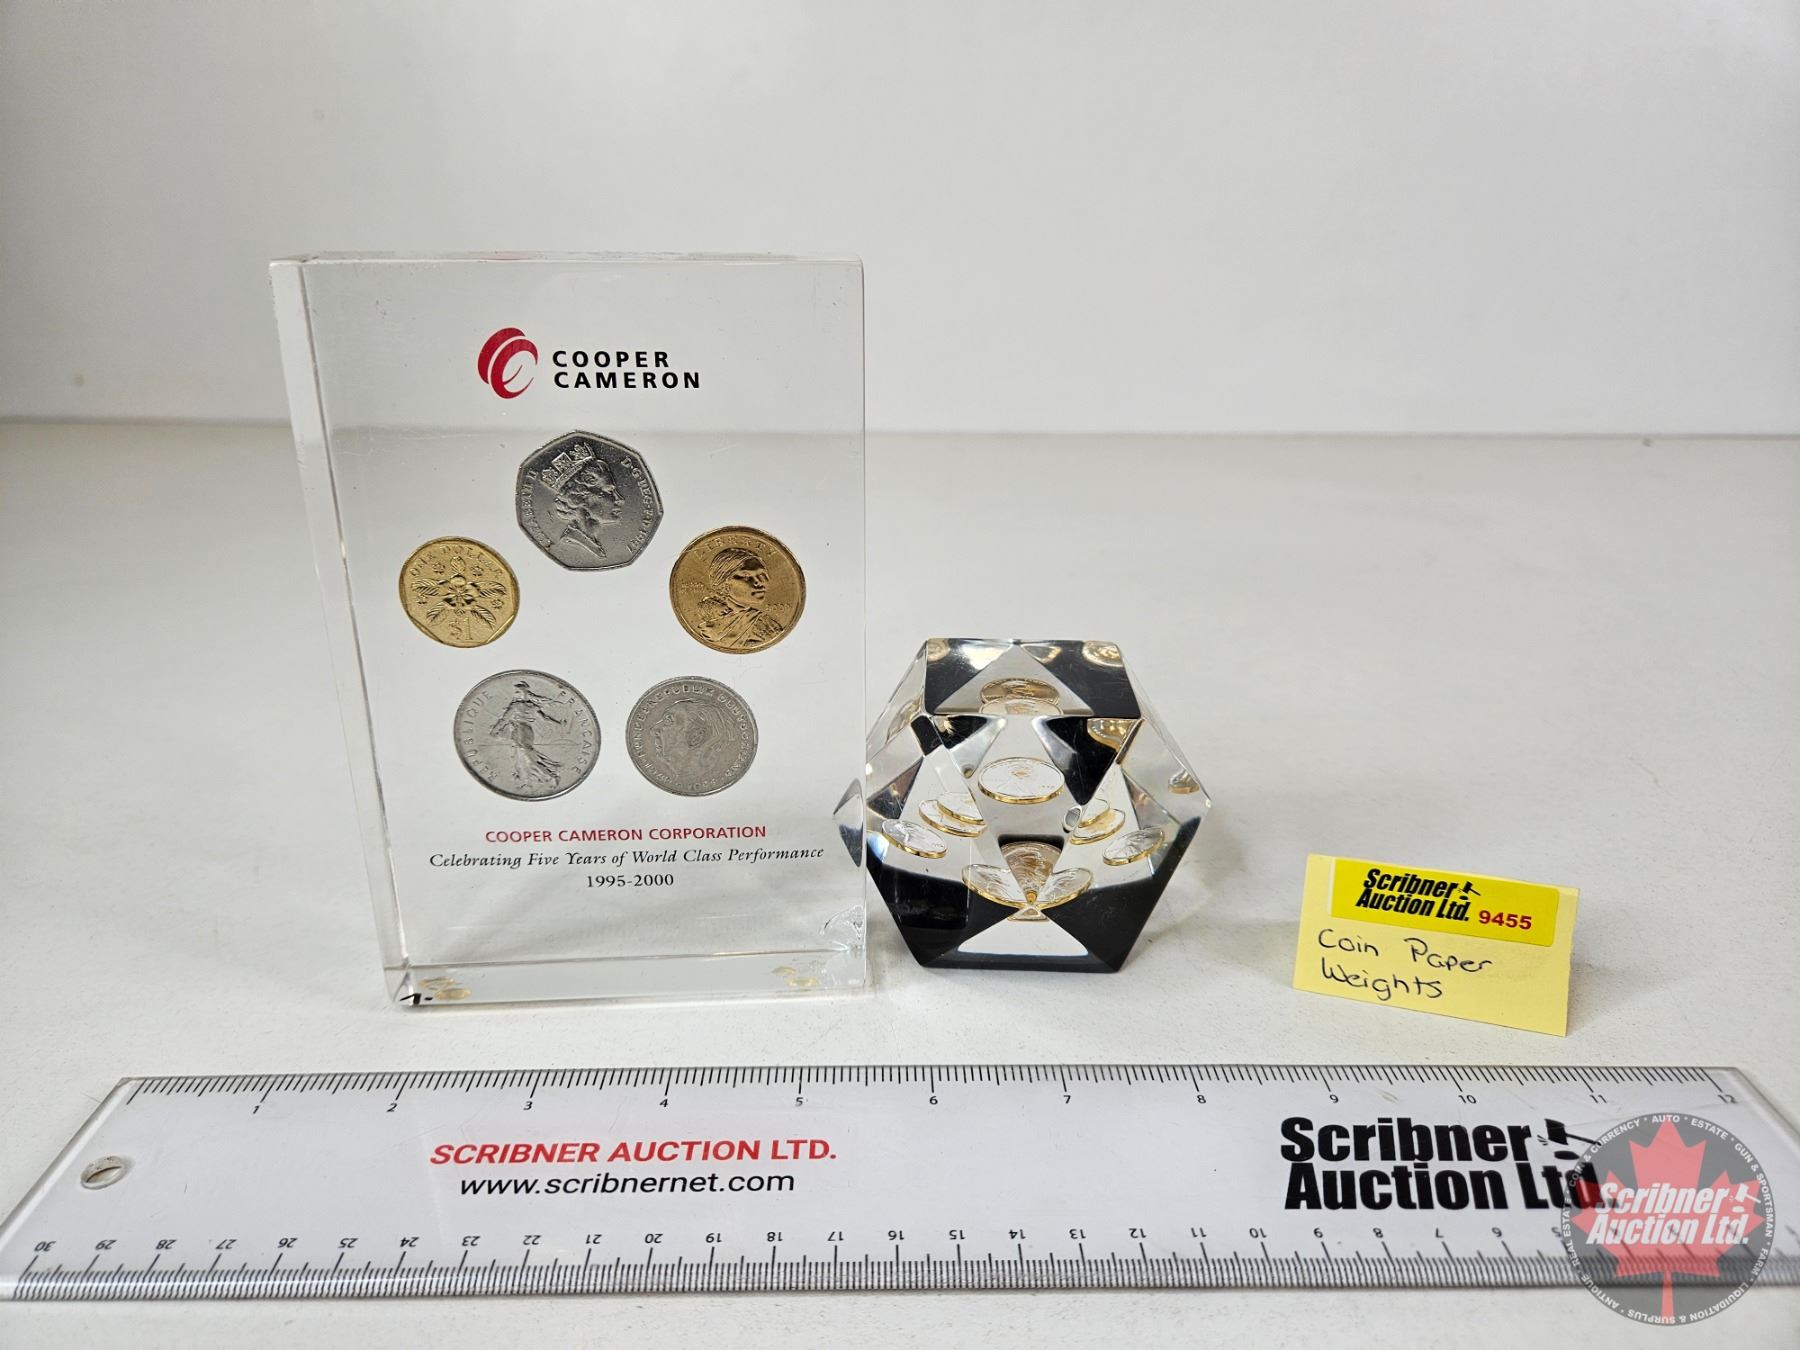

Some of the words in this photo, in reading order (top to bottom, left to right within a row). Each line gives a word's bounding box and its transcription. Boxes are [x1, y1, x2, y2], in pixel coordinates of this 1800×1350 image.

[553, 350, 669, 368] COOPER
[554, 371, 700, 389] CAMERON
[485, 830, 553, 843] COOPER
[558, 828, 643, 842] CAMERON
[648, 825, 766, 841] CORPORATION
[429, 852, 522, 870] Celebrating
[527, 851, 560, 866] Five
[566, 850, 607, 865] Years
[611, 848, 628, 867] of
[632, 848, 678, 863] World
[683, 848, 723, 862] Class
[727, 846, 824, 864] Performance
[587, 873, 674, 888] 1995-2000
[1363, 868, 1458, 898] Scribner
[1356, 888, 1433, 917] Auction
[1436, 898, 1470, 921] Ltd.
[1479, 910, 1532, 930] 9455
[1318, 929, 1379, 956] Coin
[1404, 938, 1493, 973] Paper
[1321, 957, 1443, 1001] Weights
[253, 1105, 260, 1114] 1
[387, 1103, 397, 1112] 2
[524, 1101, 533, 1110] 3
[660, 1098, 668, 1108] 4
[796, 1096, 803, 1106] 5
[930, 1095, 938, 1105] 6
[1064, 1094, 1071, 1104] 7
[1197, 1094, 1206, 1104] 8
[1330, 1094, 1339, 1104] 9
[1459, 1094, 1477, 1104] 10
[1591, 1094, 1607, 1104] 11
[1280, 1117, 1532, 1162] Scribner
[430, 1142, 601, 1165] SCRIBNER
[607, 1140, 761, 1163] AUCTION
[771, 1139, 837, 1160] LTD.
[461, 1172, 795, 1195] www.scribnernet.com
[1285, 1162, 1510, 1210] Auction
[35, 1241, 55, 1252] 30
[96, 1239, 116, 1250] 29
[156, 1239, 176, 1250] 28
[216, 1239, 236, 1250] 27
[279, 1237, 297, 1249] 26
[340, 1237, 358, 1249] 25
[401, 1236, 418, 1248] 24
[462, 1235, 480, 1247] 23
[524, 1234, 541, 1246] 22
[585, 1234, 602, 1245] 21
[645, 1233, 663, 1244] 20
[706, 1232, 722, 1243] 19
[767, 1231, 783, 1242] 18
[828, 1231, 844, 1242] 17
[888, 1230, 904, 1241] 16
[949, 1229, 965, 1240] 15
[1009, 1229, 1026, 1240] 14
[1070, 1228, 1086, 1239] 13
[1130, 1228, 1146, 1239] 12
[1191, 1228, 1206, 1238] 11
[1250, 1228, 1267, 1238] 10
[1314, 1228, 1323, 1238] 9
[1373, 1228, 1383, 1238] 8
[1435, 1228, 1443, 1238] 7
